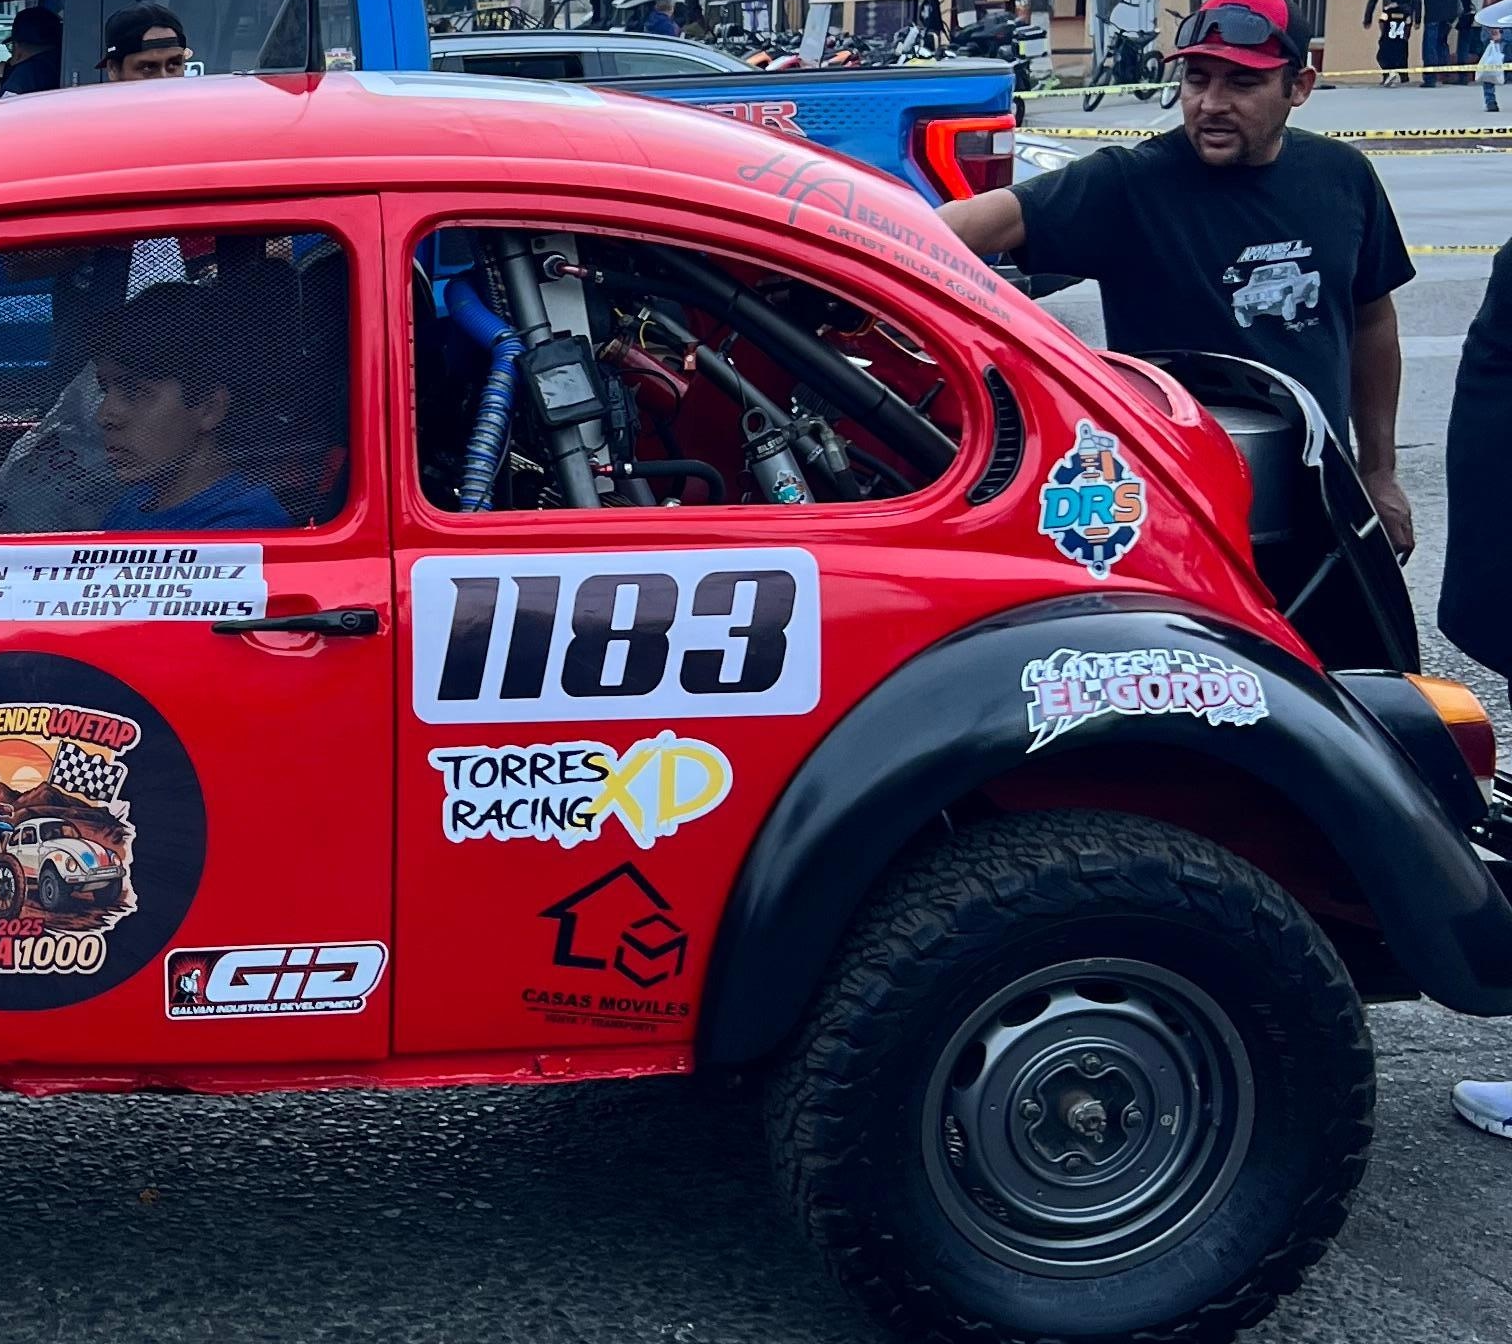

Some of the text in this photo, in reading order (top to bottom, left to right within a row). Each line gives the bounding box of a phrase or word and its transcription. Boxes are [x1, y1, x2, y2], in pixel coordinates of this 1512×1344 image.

[857, 205, 998, 295] BEAUTY STATION
[827, 224, 886, 254] ARTIST
[945, 279, 1012, 324] AGUILAR
[1044, 482, 1143, 529] DRS
[71, 549, 198, 564] RODOLFO
[114, 565, 246, 580] AGUNDEZ
[82, 583, 194, 598] CARLOS
[148, 600, 256, 616] TORRES
[437, 570, 797, 700] 1183
[1039, 670, 1259, 716] EL GORDO
[438, 750, 610, 790] TORRES
[452, 796, 597, 833] RACING
[19, 934, 100, 968] 1000
[171, 1004, 215, 1016] GALVAN
[216, 1001, 278, 1014] INDUSTRIES
[521, 988, 690, 1017] CASAS MOVILES
